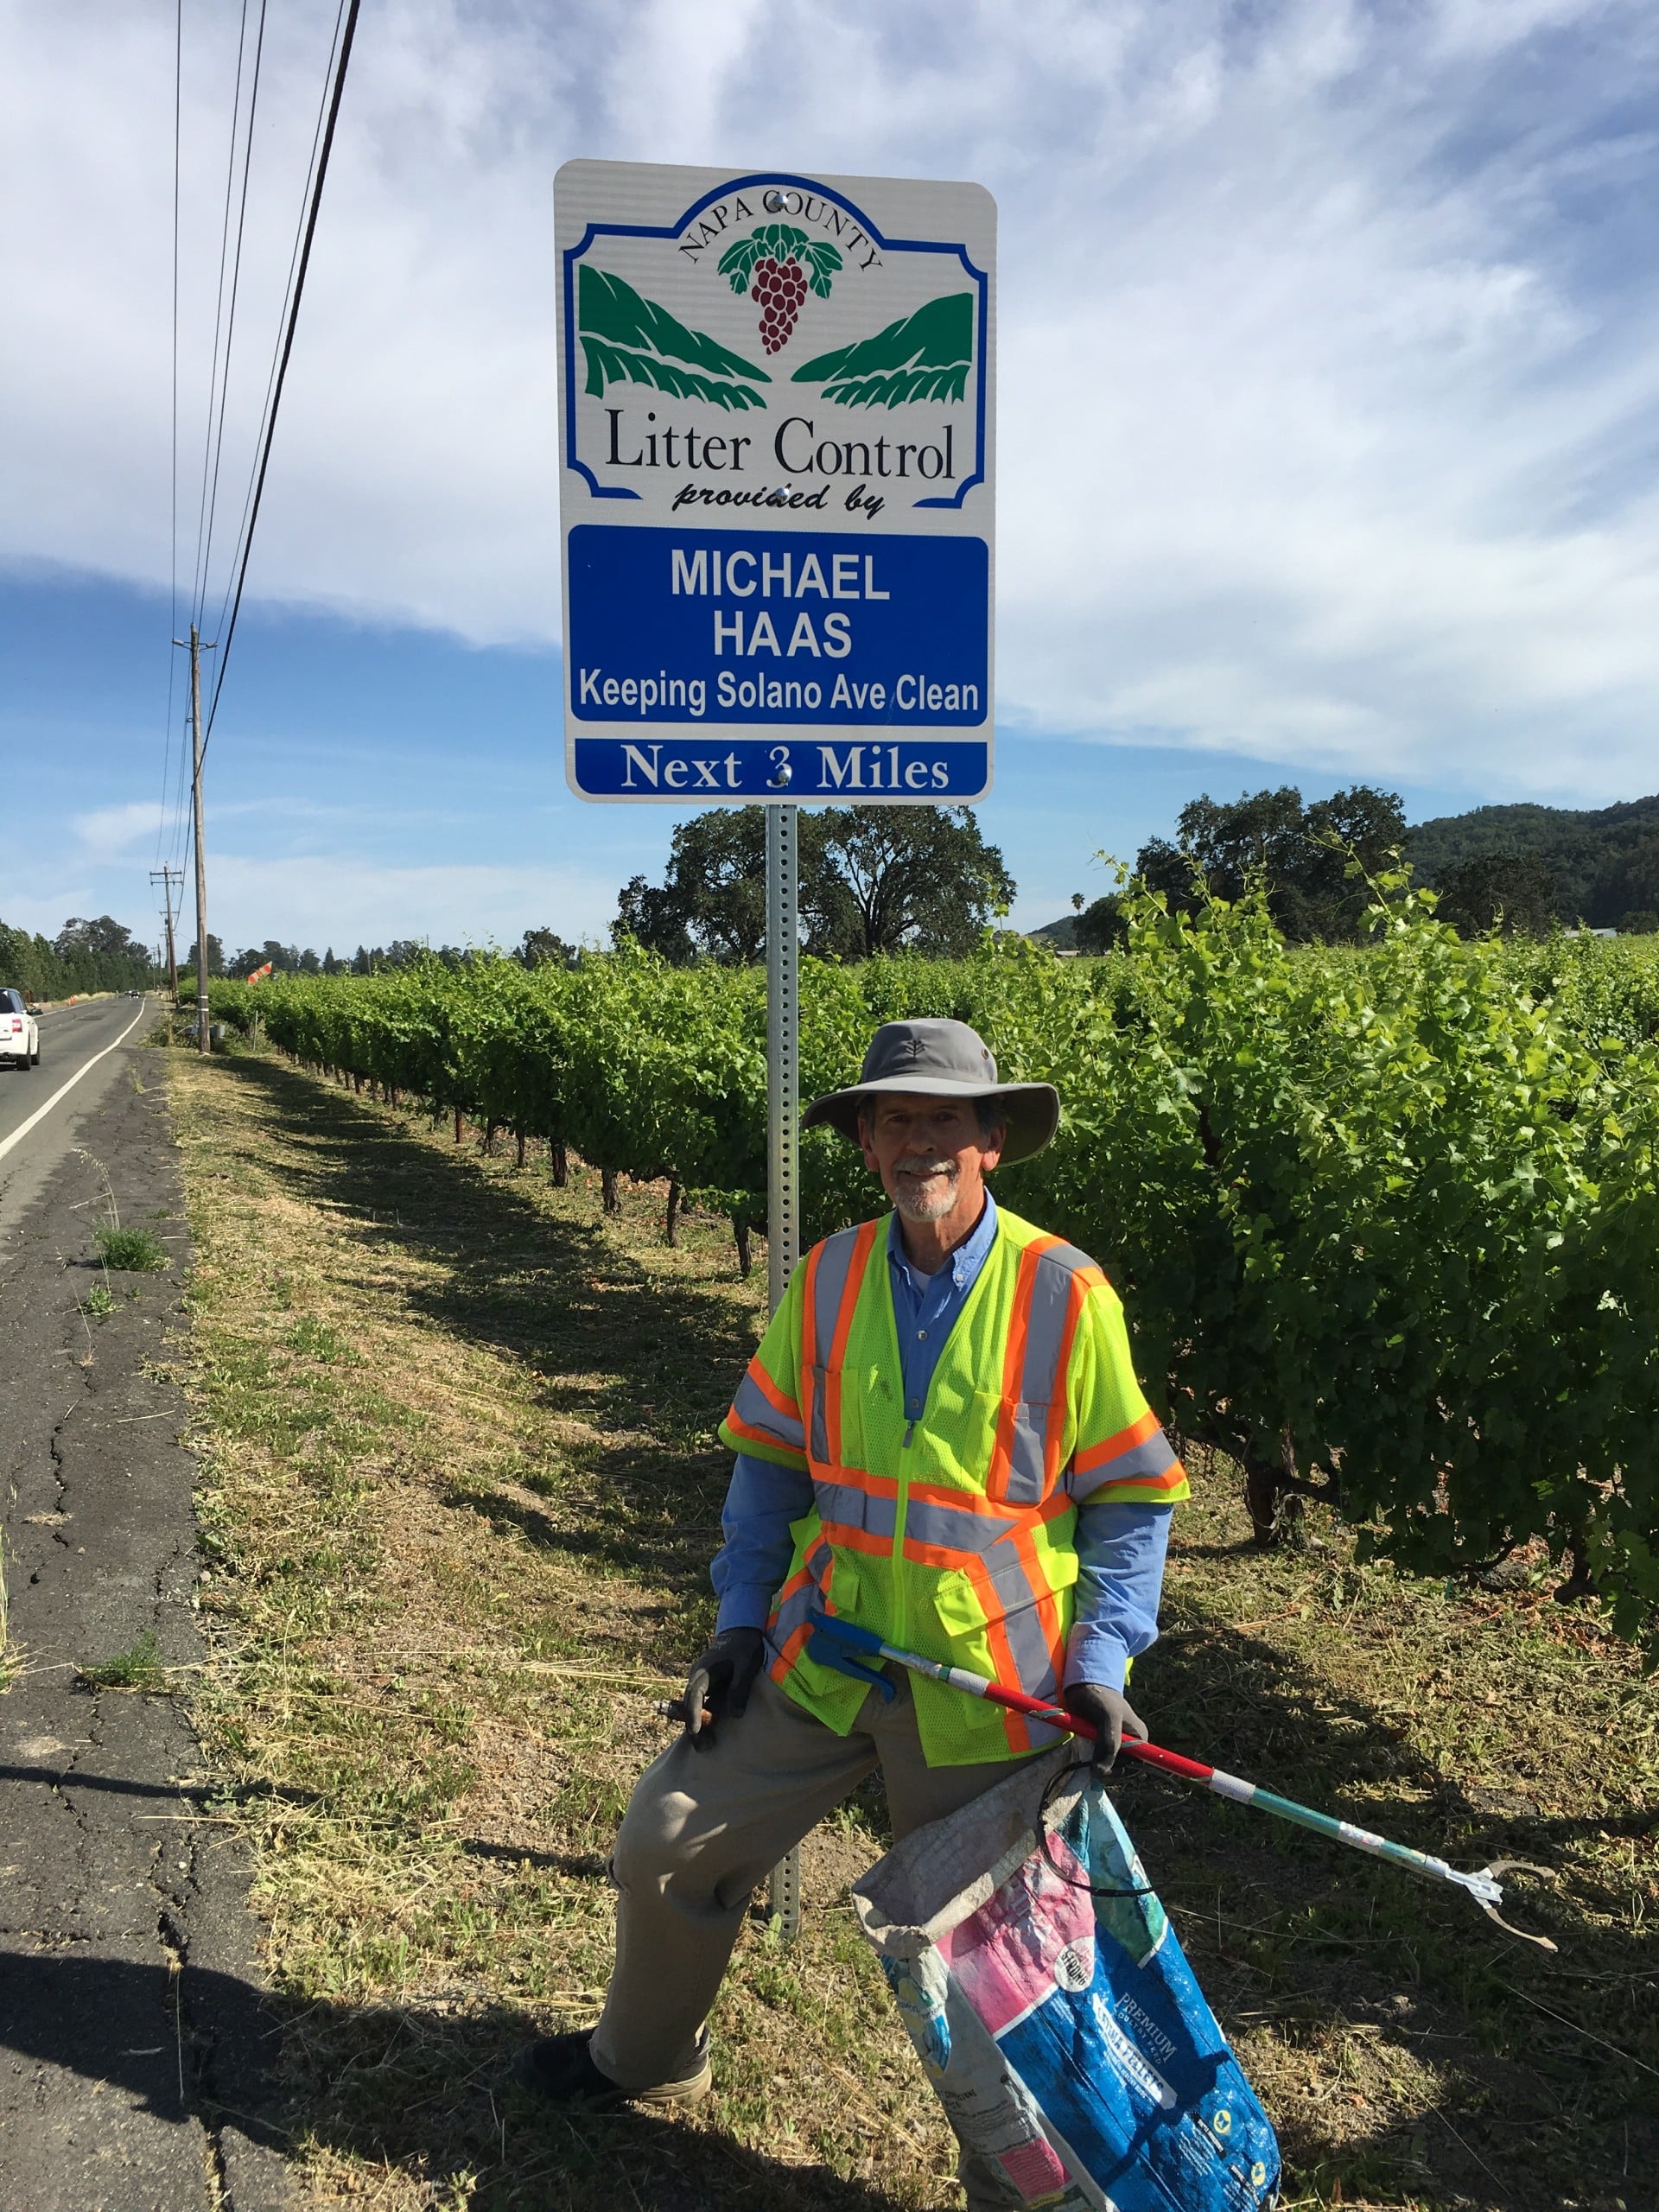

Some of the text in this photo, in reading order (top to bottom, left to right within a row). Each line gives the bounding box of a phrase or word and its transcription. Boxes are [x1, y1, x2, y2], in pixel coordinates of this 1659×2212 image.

[678, 189, 883, 272] NAPA COUNTY
[604, 409, 956, 480] Litter Control
[671, 483, 886, 520] provided by
[671, 549, 891, 600] MICHAEL
[714, 610, 852, 658] HAAS
[580, 668, 978, 716] Keeping Solano Ave Clean
[620, 744, 949, 790] Next 3 Miles
[1060, 1950, 1088, 1985] STRONG
[1114, 2006, 1147, 2037] OULTRY
[1114, 1993, 1177, 2063] PREMIUM
